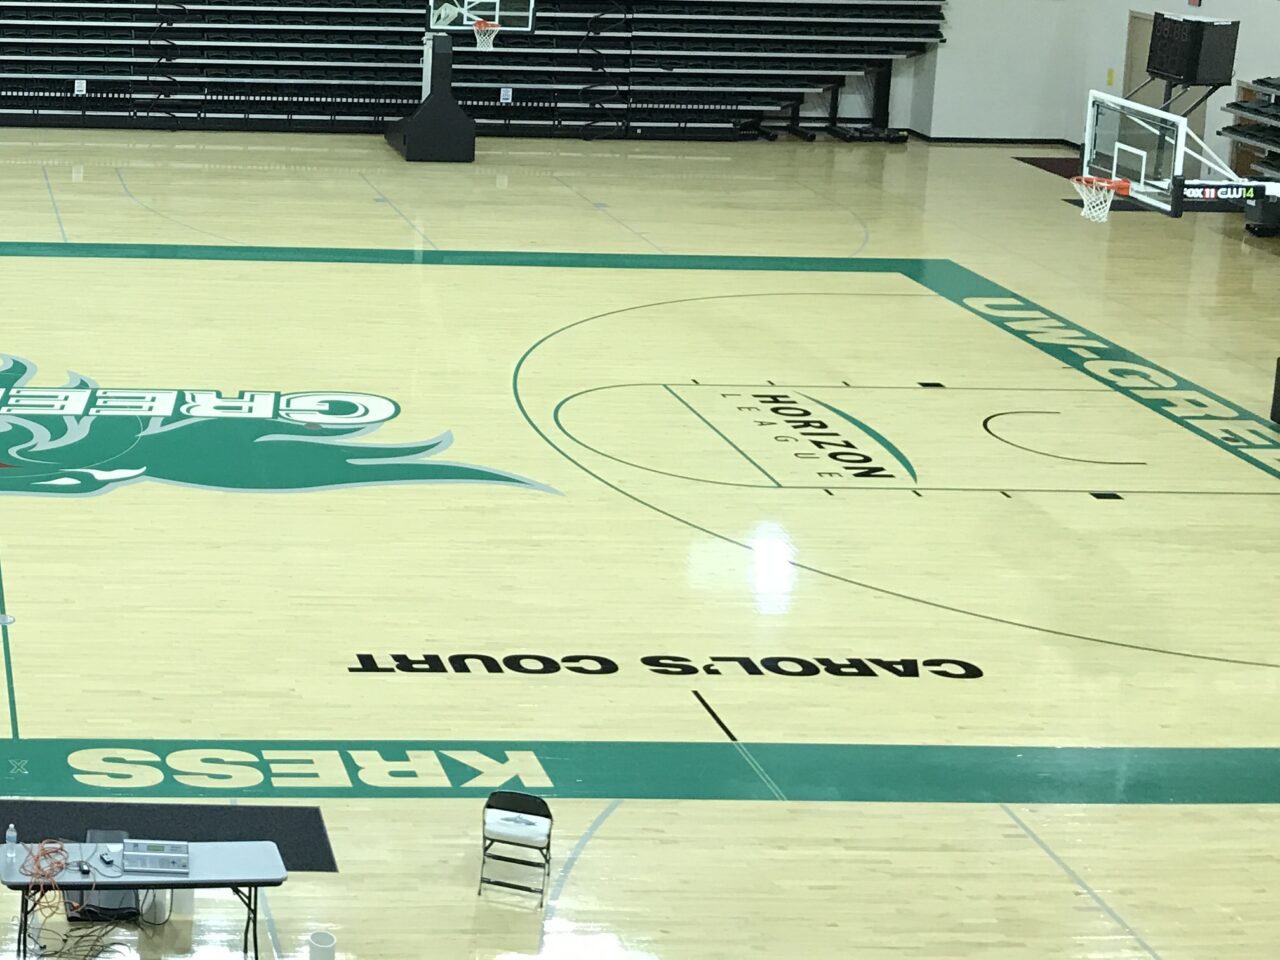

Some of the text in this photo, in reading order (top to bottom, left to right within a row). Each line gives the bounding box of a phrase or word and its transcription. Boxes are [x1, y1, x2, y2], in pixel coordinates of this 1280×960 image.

[720, 393, 843, 478] LEAGUE
[751, 394, 896, 478] HORIZON
[348, 653, 984, 679] CAROL'S COURT
[67, 748, 554, 788] KRESS
